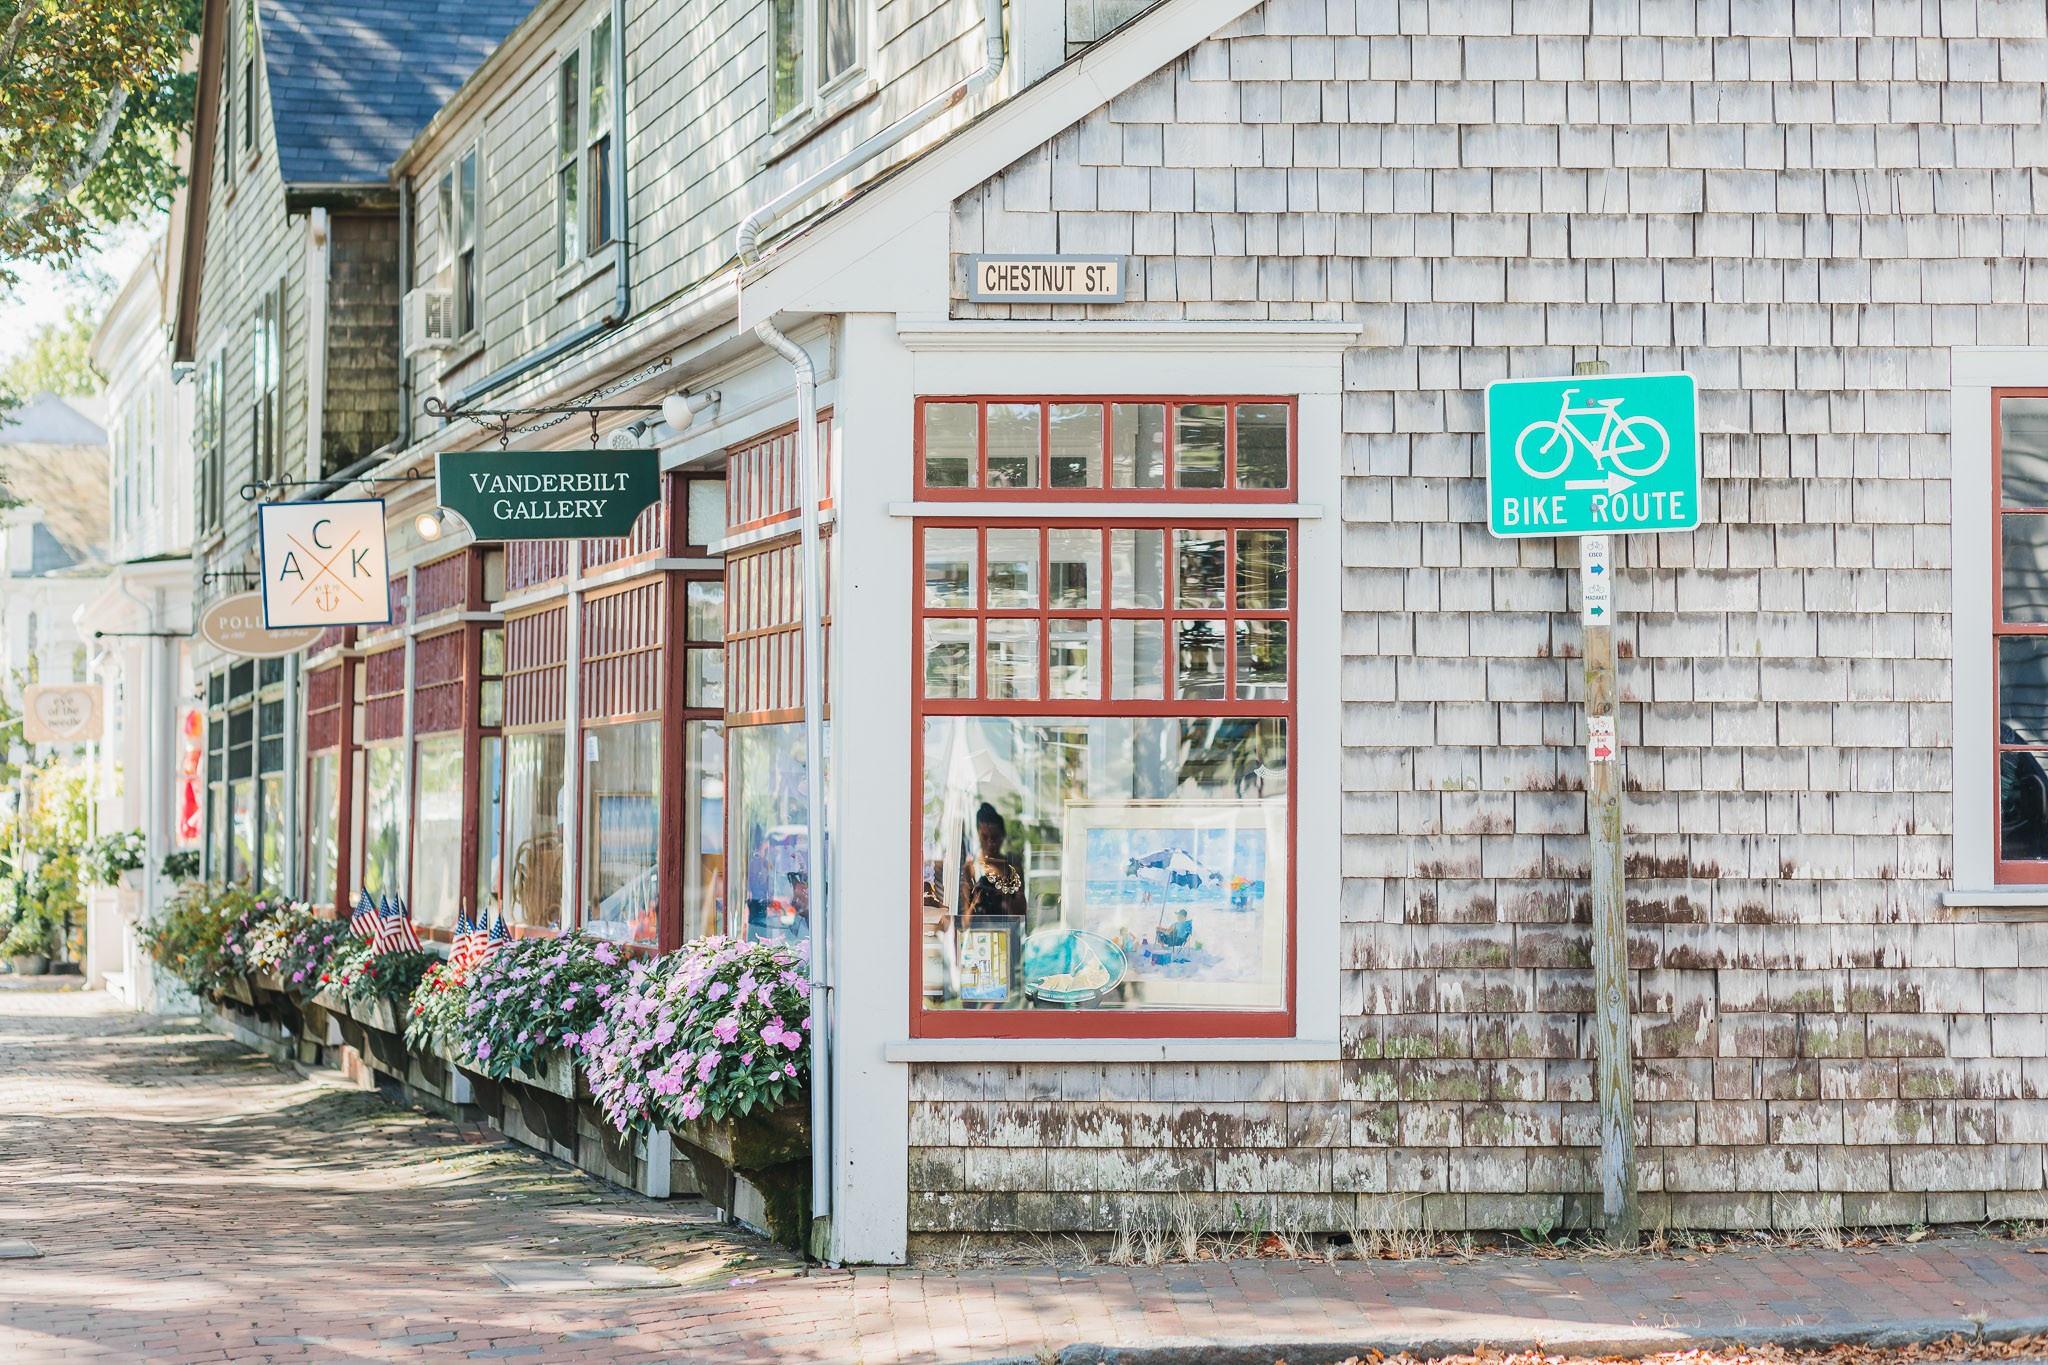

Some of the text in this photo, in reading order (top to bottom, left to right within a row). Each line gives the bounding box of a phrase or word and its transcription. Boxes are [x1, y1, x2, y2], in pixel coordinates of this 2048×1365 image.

[985, 264, 1110, 292] CHESTNUT ST.
[469, 472, 630, 494] VANDERBILT
[493, 499, 608, 520] GALLERY
[1503, 490, 1686, 526] BIKE ROUTE
